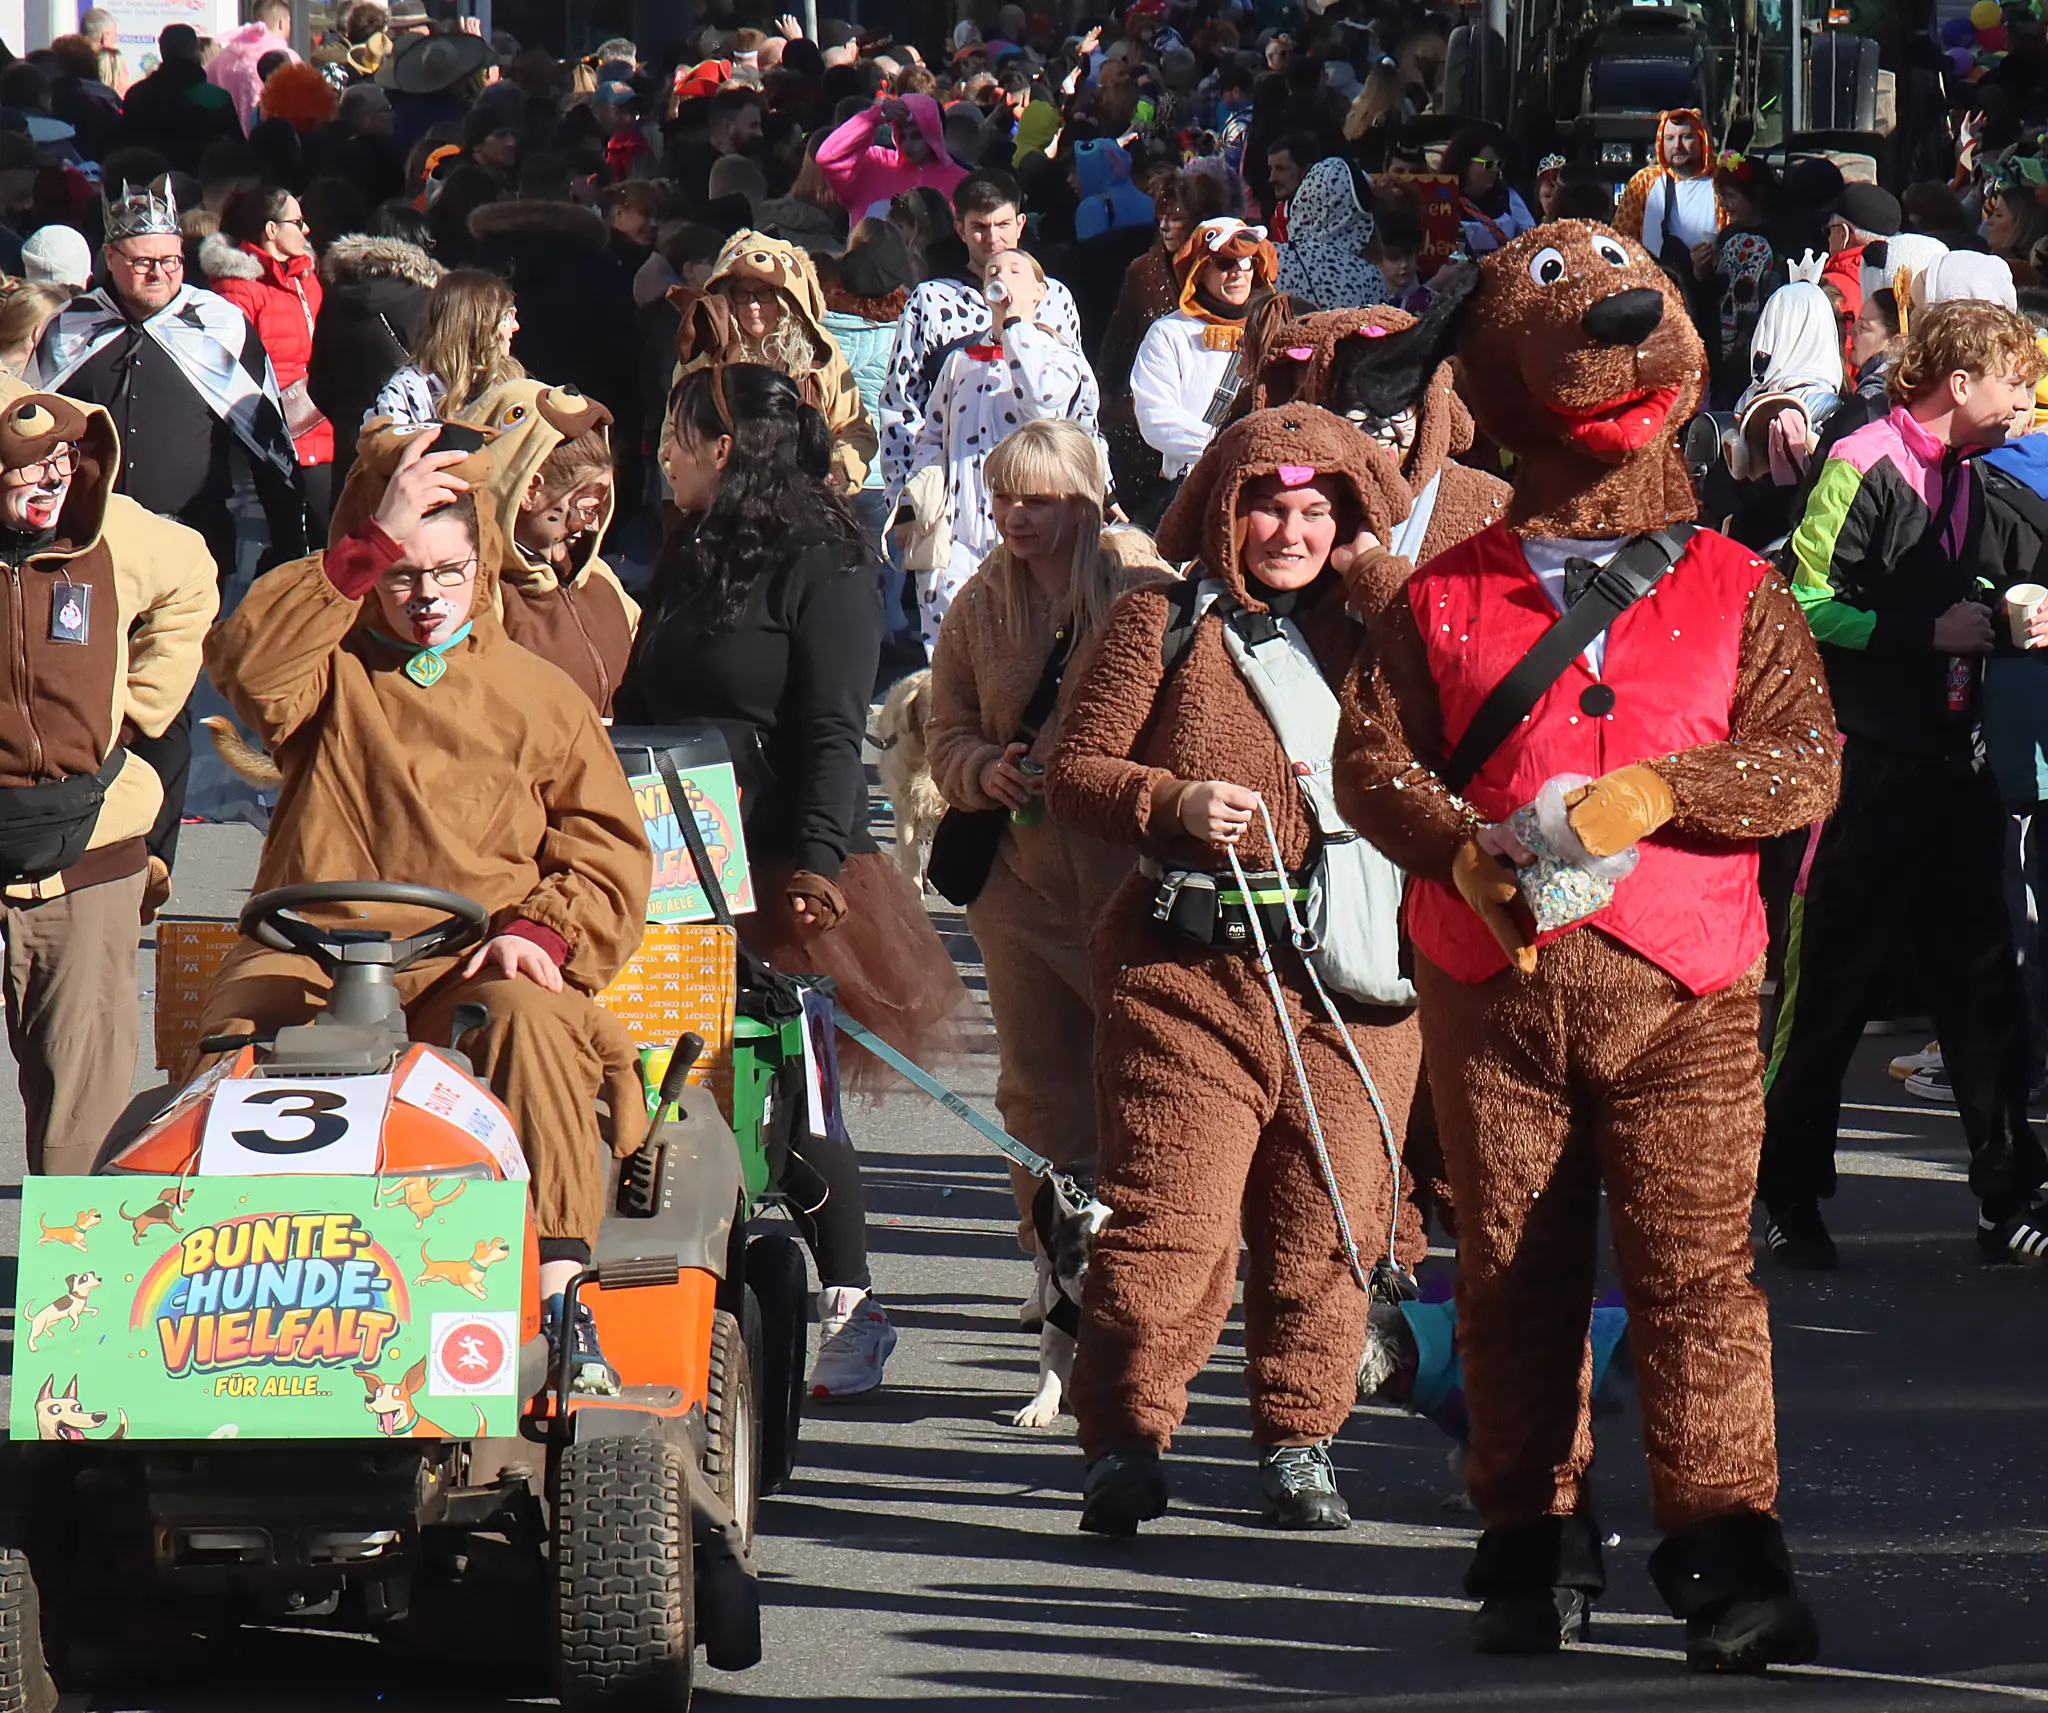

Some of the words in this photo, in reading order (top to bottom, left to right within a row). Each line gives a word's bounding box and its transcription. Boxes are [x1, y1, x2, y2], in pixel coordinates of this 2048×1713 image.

[411, 656, 440, 680] SD
[648, 895, 664, 914] ÜR
[231, 1089, 349, 1155] 3
[181, 1213, 372, 1278] BUNTE-
[157, 1307, 396, 1373] VIELFALT
[214, 1374, 258, 1397] FÜR
[261, 1376, 333, 1397] ALLE...
